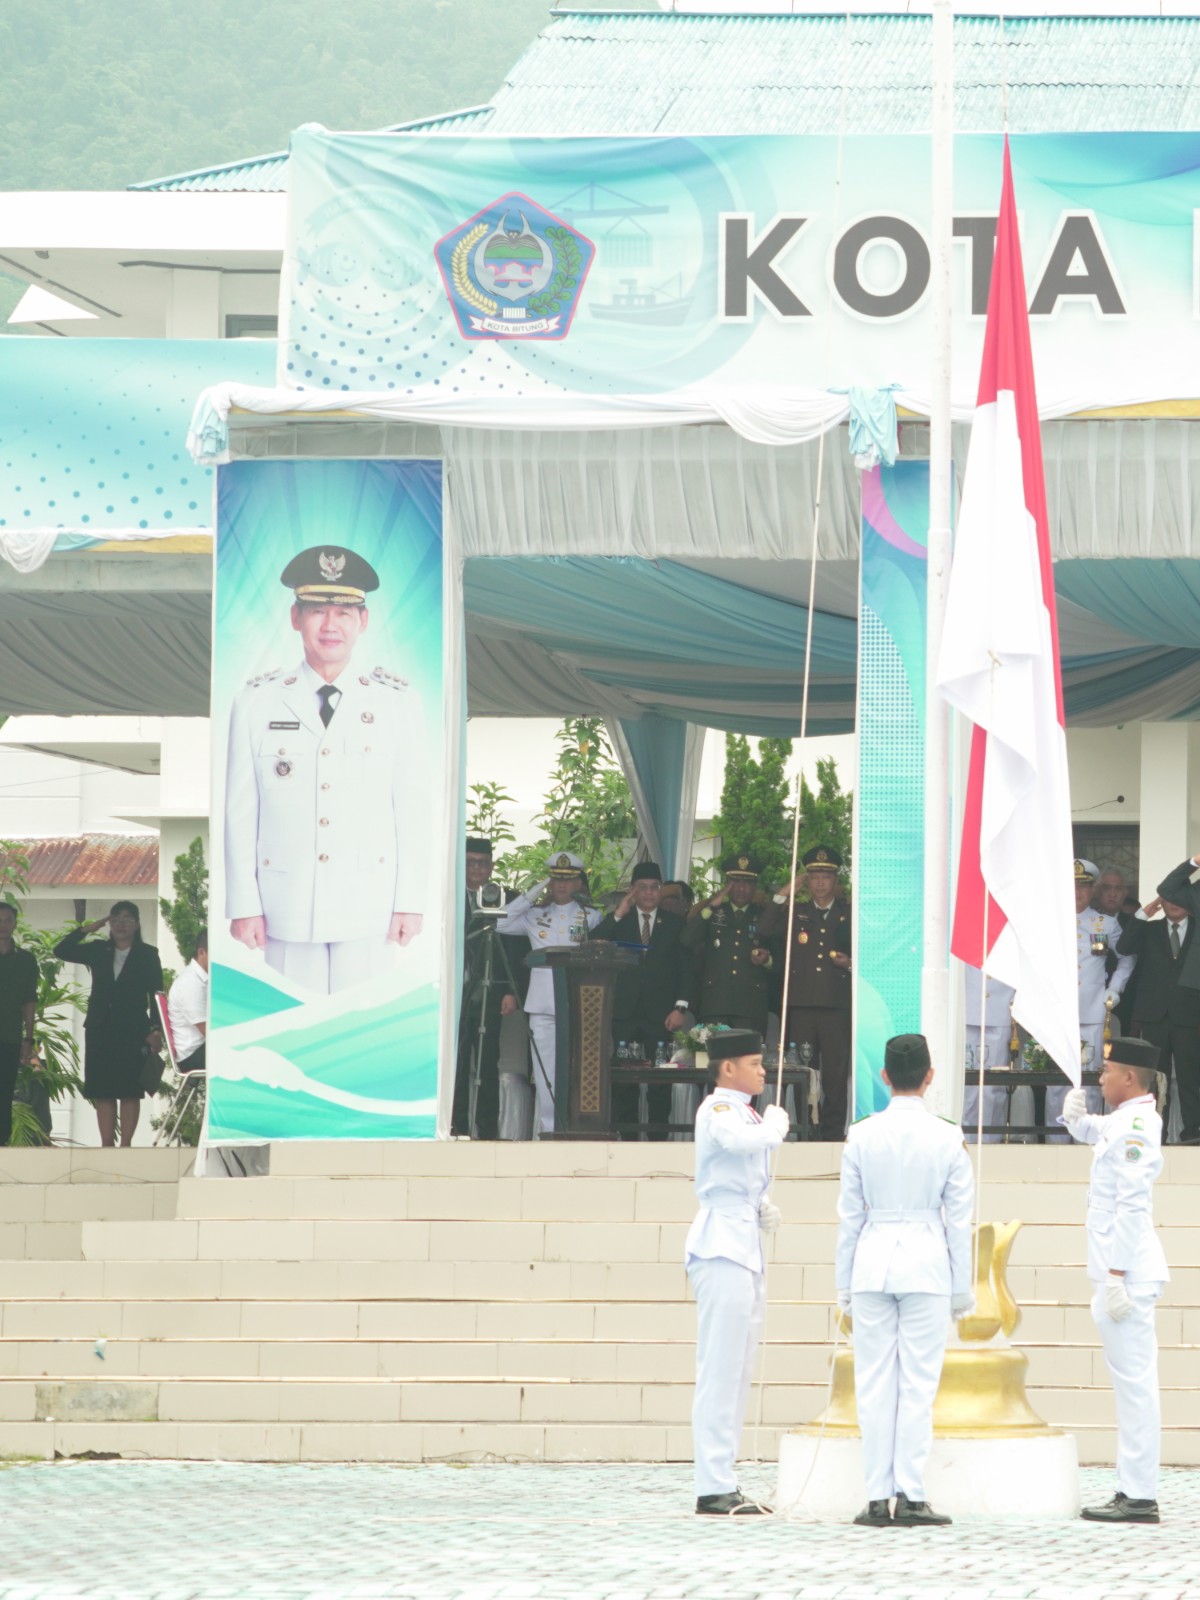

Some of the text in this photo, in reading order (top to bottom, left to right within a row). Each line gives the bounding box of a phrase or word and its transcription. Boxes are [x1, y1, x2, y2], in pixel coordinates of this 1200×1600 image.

[725, 216, 1127, 317] KOTA
[487, 322, 544, 332] KOTA BITUNG
